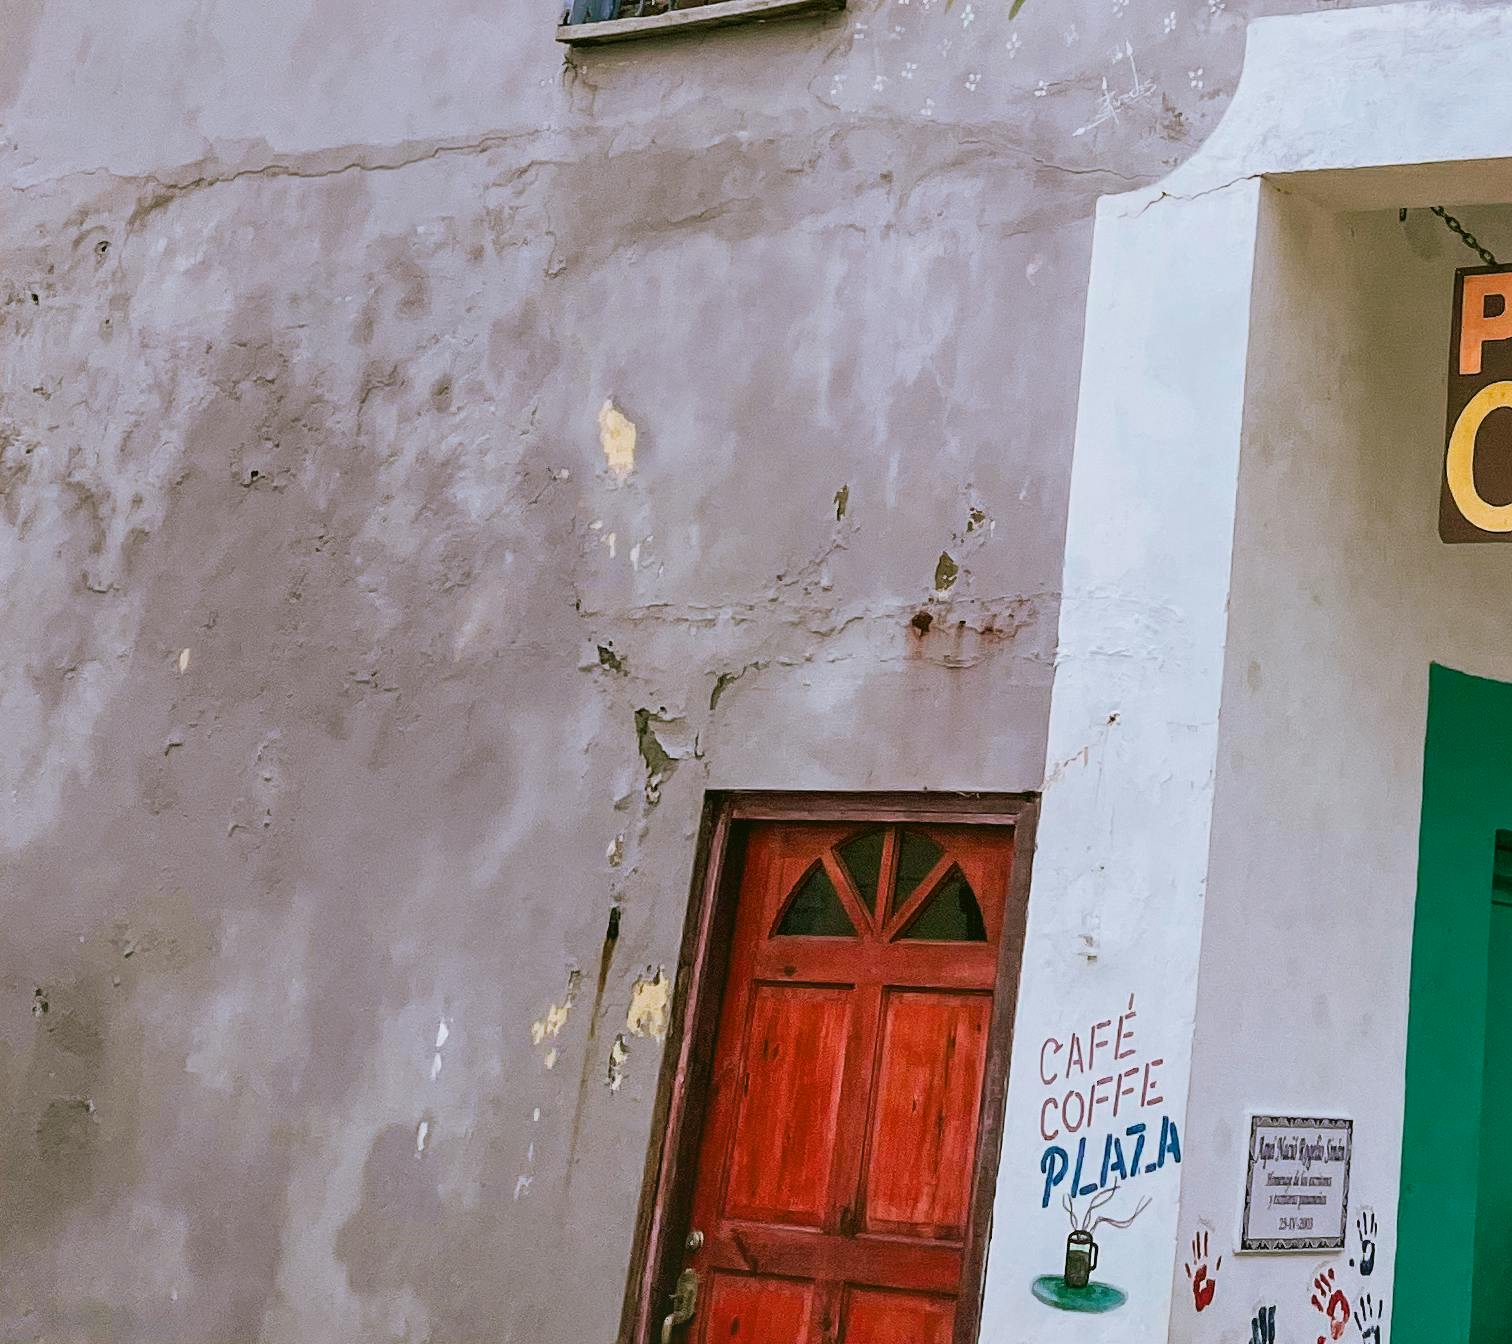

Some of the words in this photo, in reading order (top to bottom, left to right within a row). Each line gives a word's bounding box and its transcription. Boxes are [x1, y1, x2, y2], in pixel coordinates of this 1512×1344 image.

[1040, 992, 1137, 1085] CAFÉ
[1040, 1058, 1164, 1141] COFFE
[1040, 1115, 1181, 1208] PLAZA
